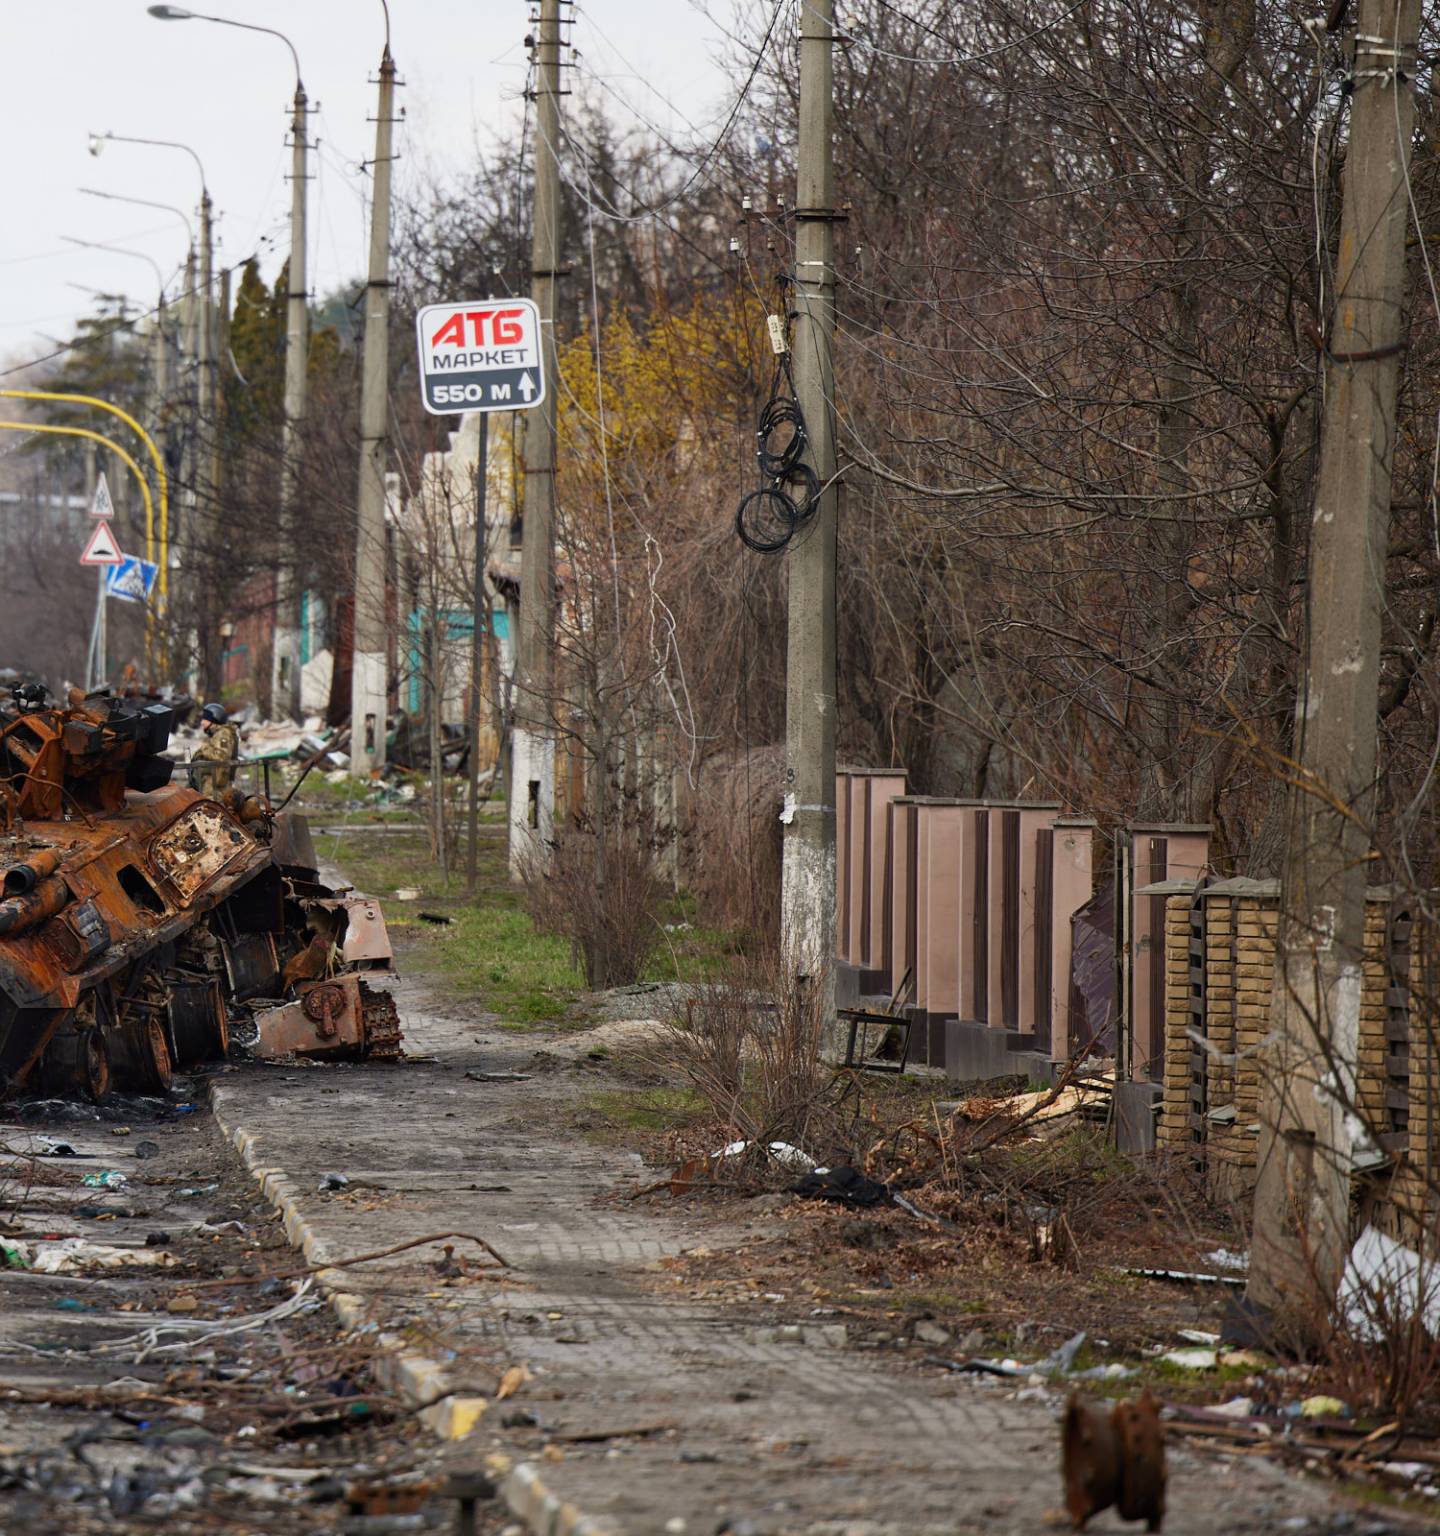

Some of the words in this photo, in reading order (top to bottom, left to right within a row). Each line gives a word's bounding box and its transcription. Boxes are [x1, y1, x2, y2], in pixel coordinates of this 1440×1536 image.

[432, 309, 525, 348] АТБ
[433, 349, 528, 369] МАРКЕТ
[433, 384, 482, 403] 550
